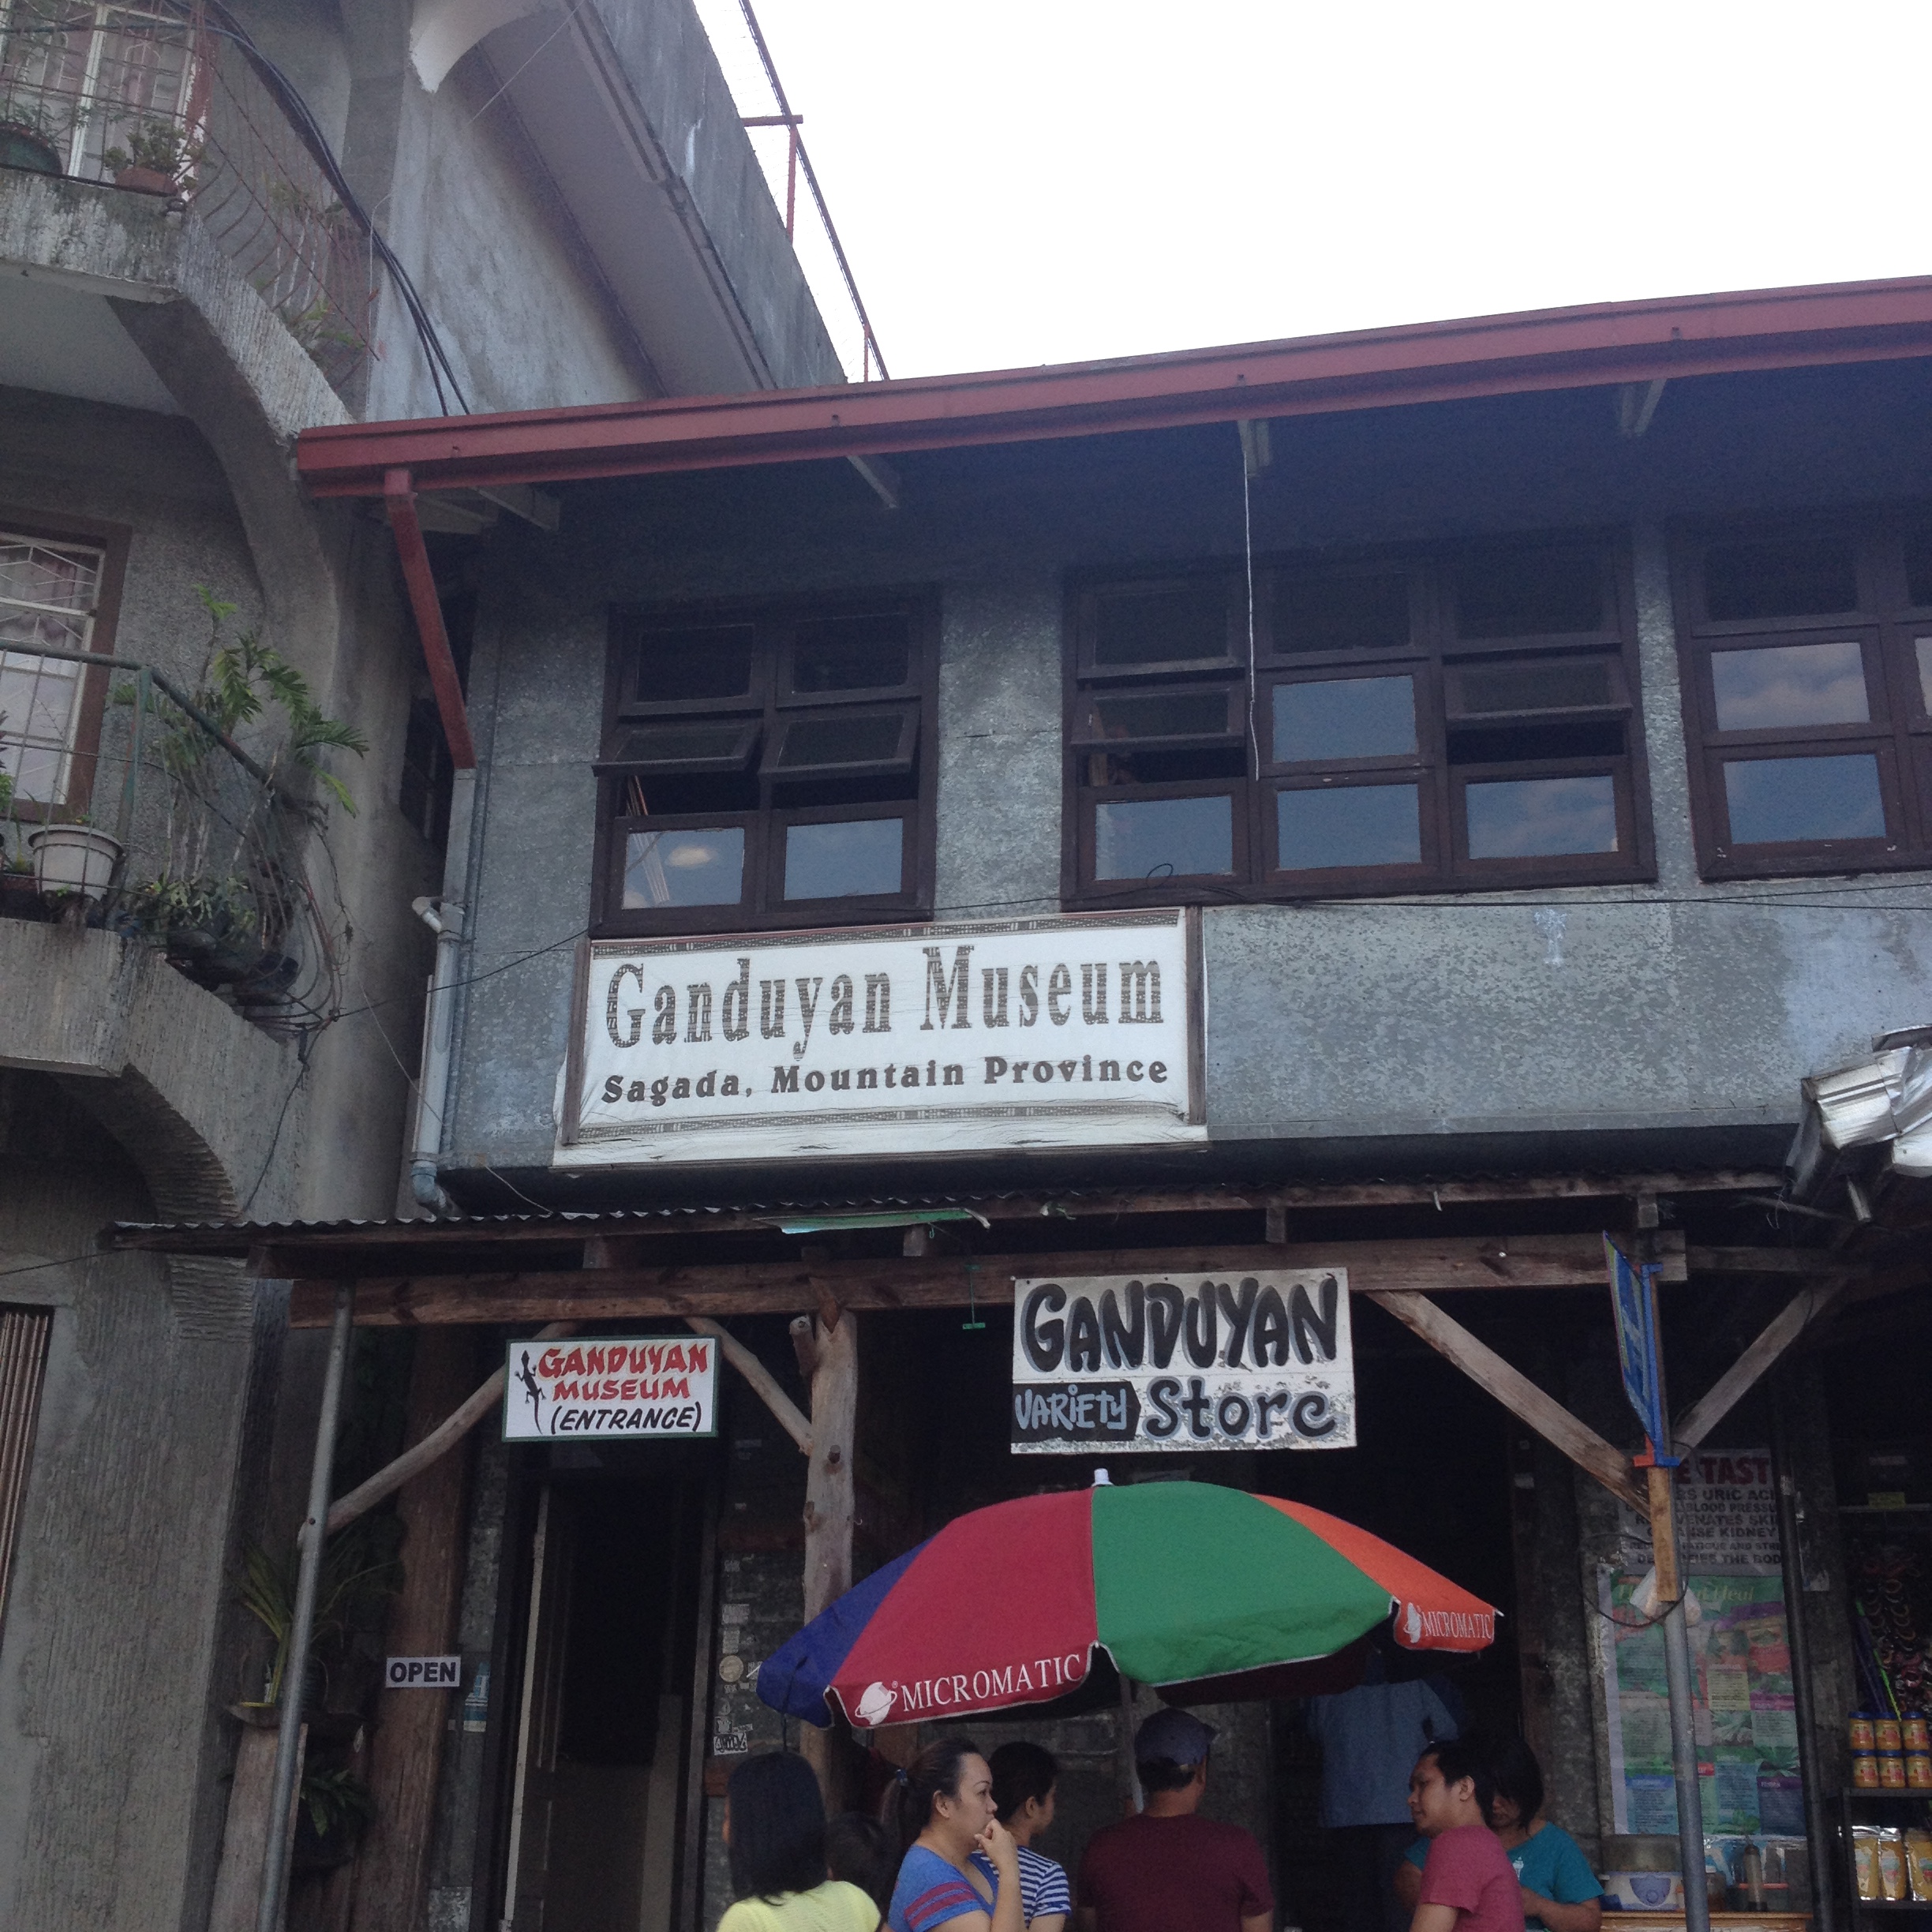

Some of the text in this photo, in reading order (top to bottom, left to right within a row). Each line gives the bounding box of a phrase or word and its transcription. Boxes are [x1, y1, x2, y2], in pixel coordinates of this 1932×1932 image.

[607, 945, 1164, 1061] Ganduyan Museum
[601, 1055, 1168, 1106] Sagada, Mountain Province
[1020, 1276, 1339, 1373] GANDUYAN
[537, 1342, 708, 1379] GANDUYAN
[552, 1377, 691, 1402] MUSEUM
[551, 1401, 702, 1435] (ENTRANCE)
[1141, 1375, 1339, 1441] Store
[1699, 1457, 1769, 1485] TAST
[1702, 1488, 1742, 1500] URIC
[1747, 1488, 1776, 1500] ACI
[1729, 1503, 1777, 1513] PRESSU
[1723, 1554, 1749, 1564] THE
[1753, 1553, 1781, 1564] BOD
[1421, 1611, 1492, 1639] MICROMATIC
[389, 1661, 456, 1683] OPEN
[900, 1653, 1083, 1712] MICROMATIC
